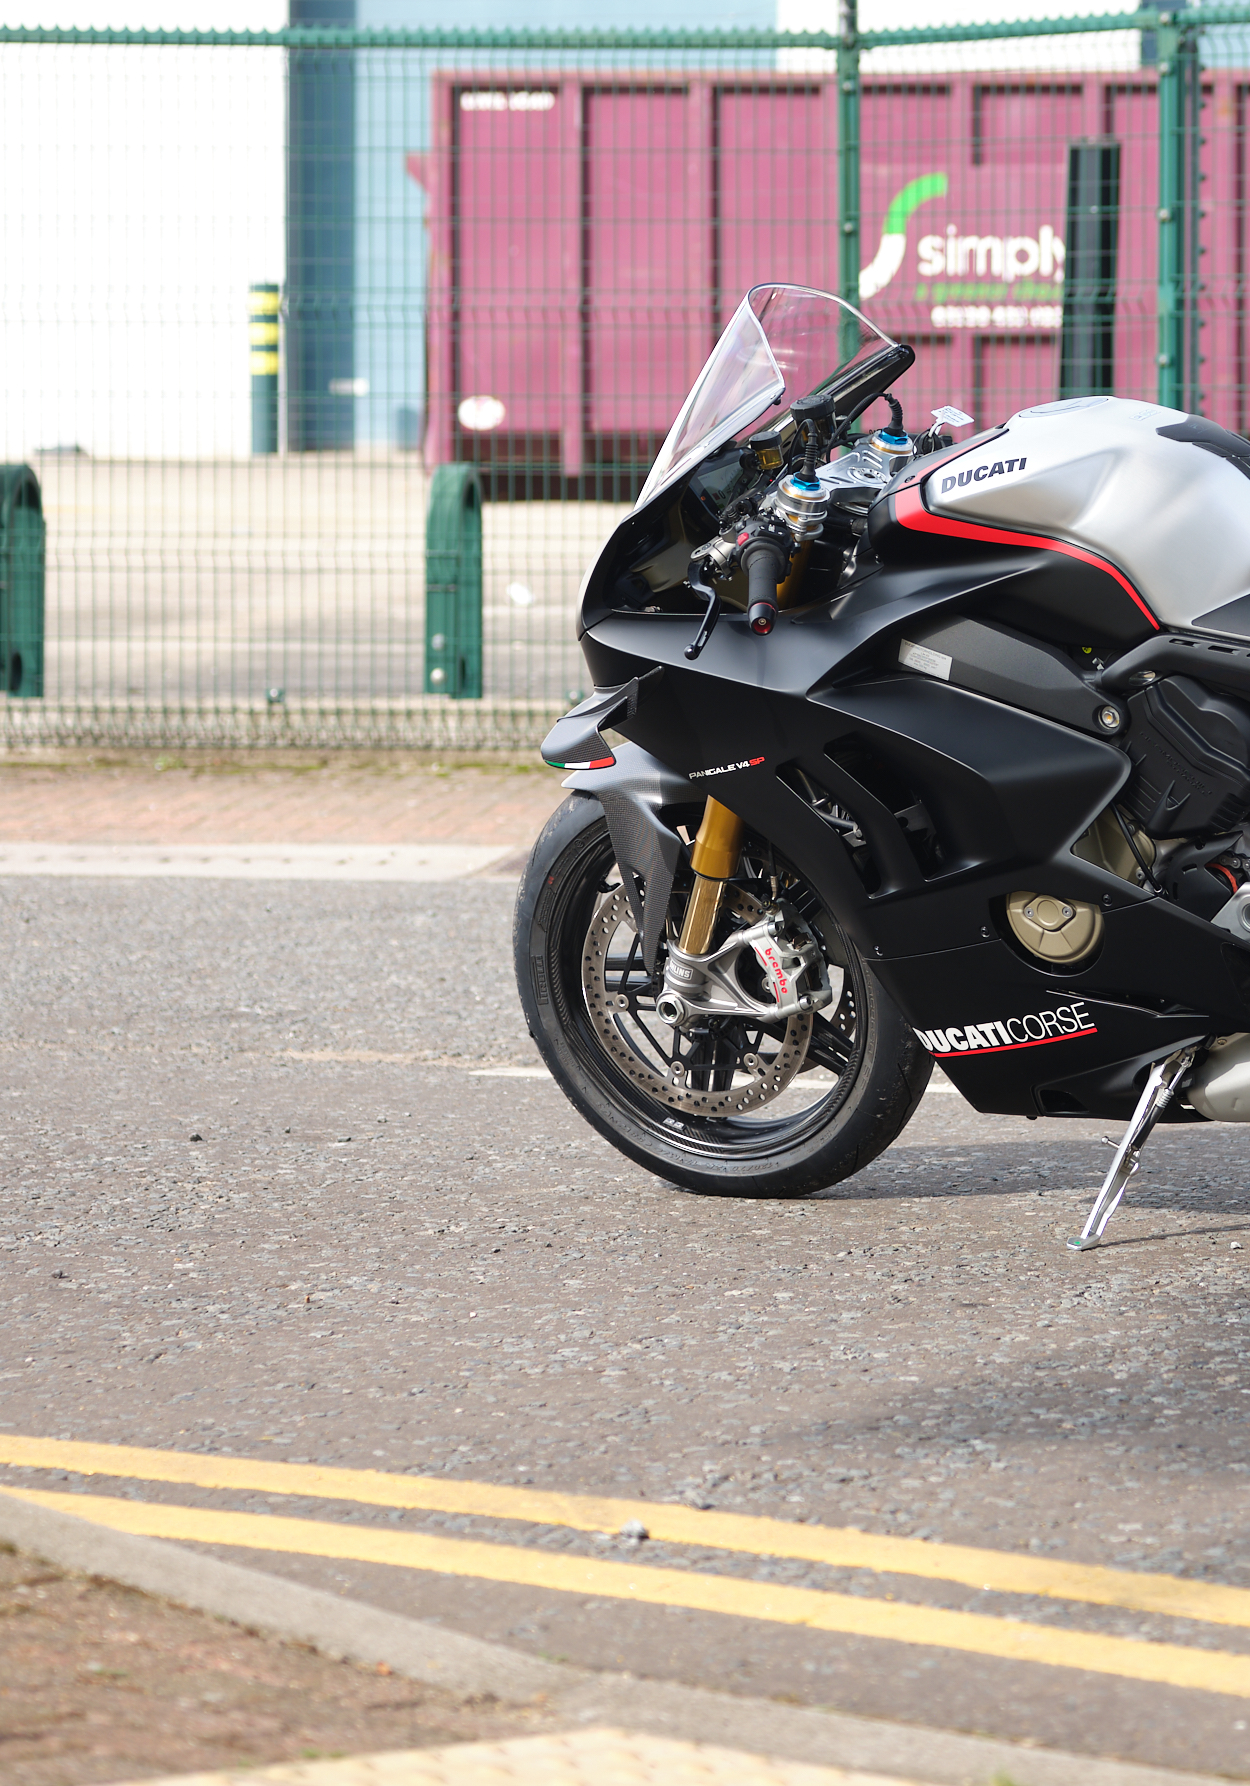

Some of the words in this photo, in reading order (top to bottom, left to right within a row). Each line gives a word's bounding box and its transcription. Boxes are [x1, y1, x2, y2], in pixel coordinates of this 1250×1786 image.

[941, 457, 1027, 494] DUCATI
[688, 764, 736, 779] PANIGALE
[764, 947, 789, 995] brembo
